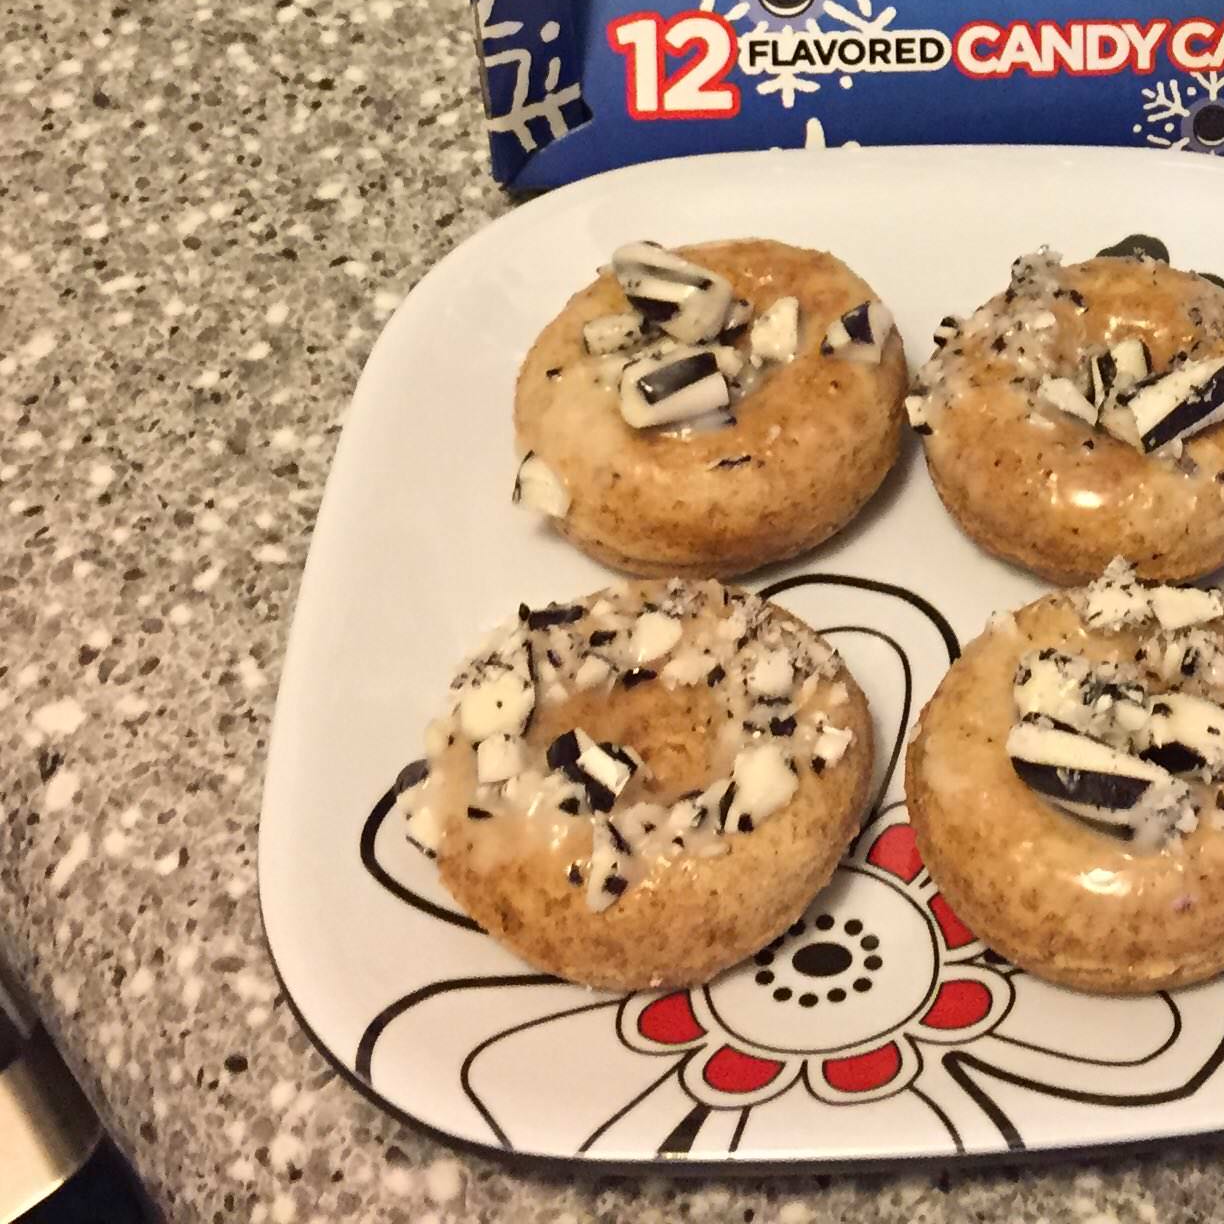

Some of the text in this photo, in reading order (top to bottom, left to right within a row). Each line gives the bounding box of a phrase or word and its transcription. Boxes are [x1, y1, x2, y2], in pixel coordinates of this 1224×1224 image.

[611, 14, 739, 116] 12
[749, 38, 945, 67] FLAVORED
[957, 22, 1168, 74] CANDY
